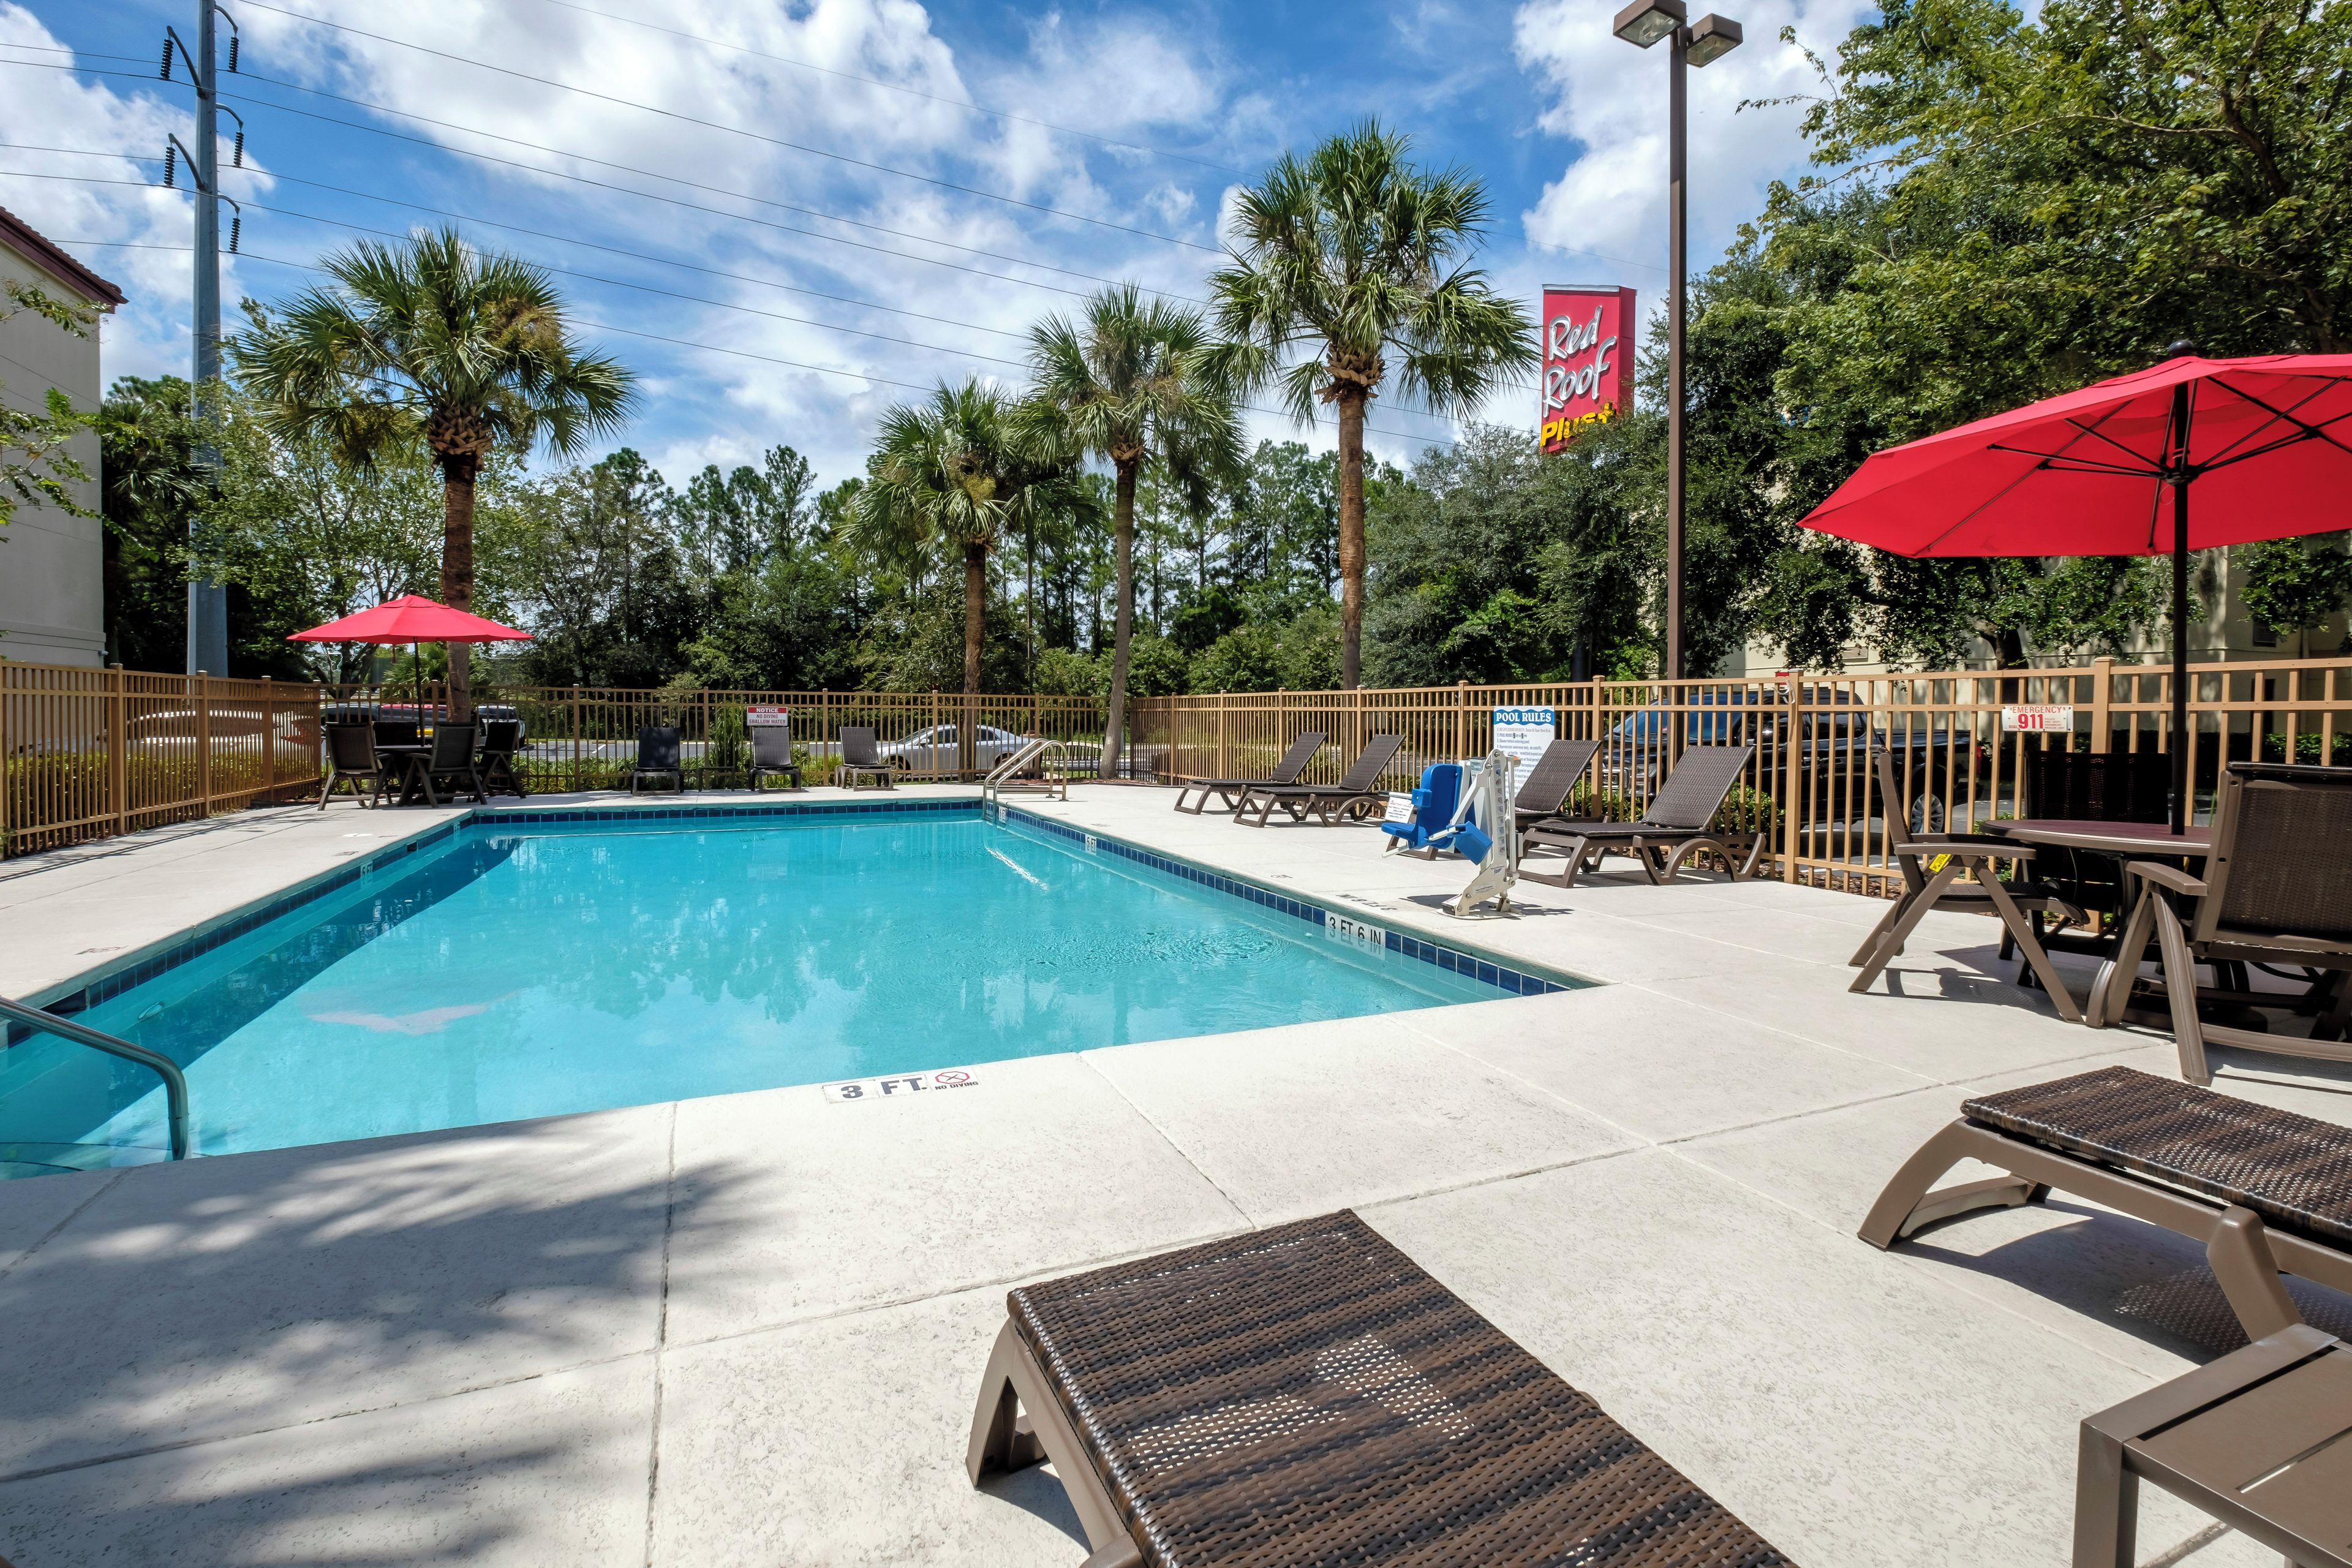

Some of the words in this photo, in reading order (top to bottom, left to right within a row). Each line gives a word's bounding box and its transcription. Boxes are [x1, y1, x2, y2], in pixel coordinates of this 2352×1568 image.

[1548, 306, 1603, 361] Red
[1542, 336, 1617, 418] Roof
[1496, 712, 1520, 722] POOL
[1522, 712, 1551, 723] RULES
[2018, 714, 2043, 729] 911
[1329, 916, 1336, 930] 3
[1341, 919, 1353, 935] FT
[1358, 926, 1365, 940] 6
[1370, 929, 1381, 945] IN
[841, 1085, 864, 1099] 3
[880, 1077, 928, 1095] FT.
